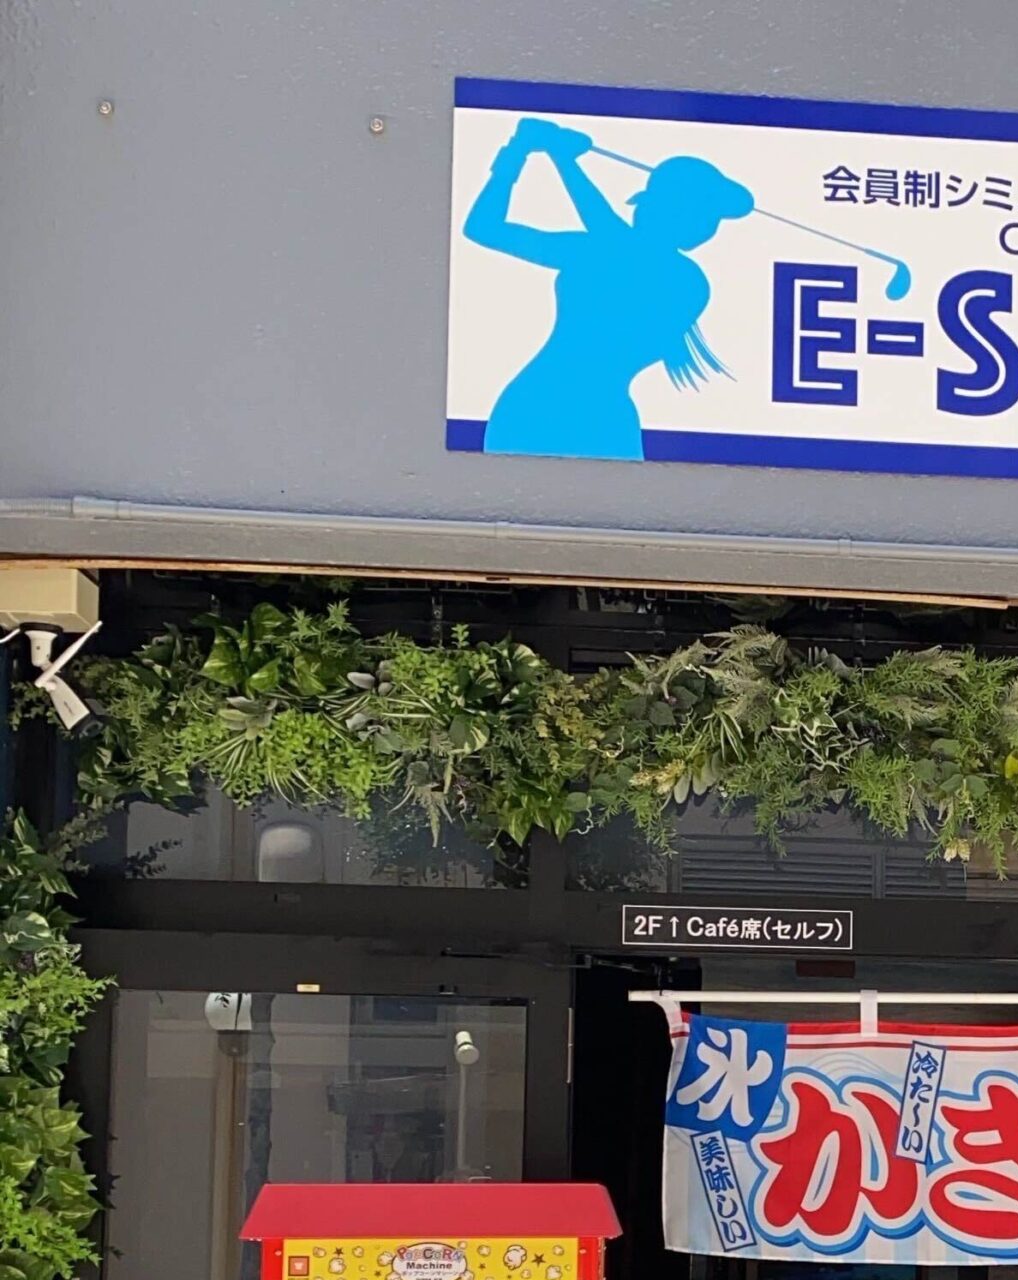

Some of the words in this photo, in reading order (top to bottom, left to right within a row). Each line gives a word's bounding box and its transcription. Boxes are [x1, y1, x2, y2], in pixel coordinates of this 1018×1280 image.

[633, 915, 664, 936] 2F
[674, 1027, 775, 1126] 氷
[696, 1136, 752, 1244] 美味しい
